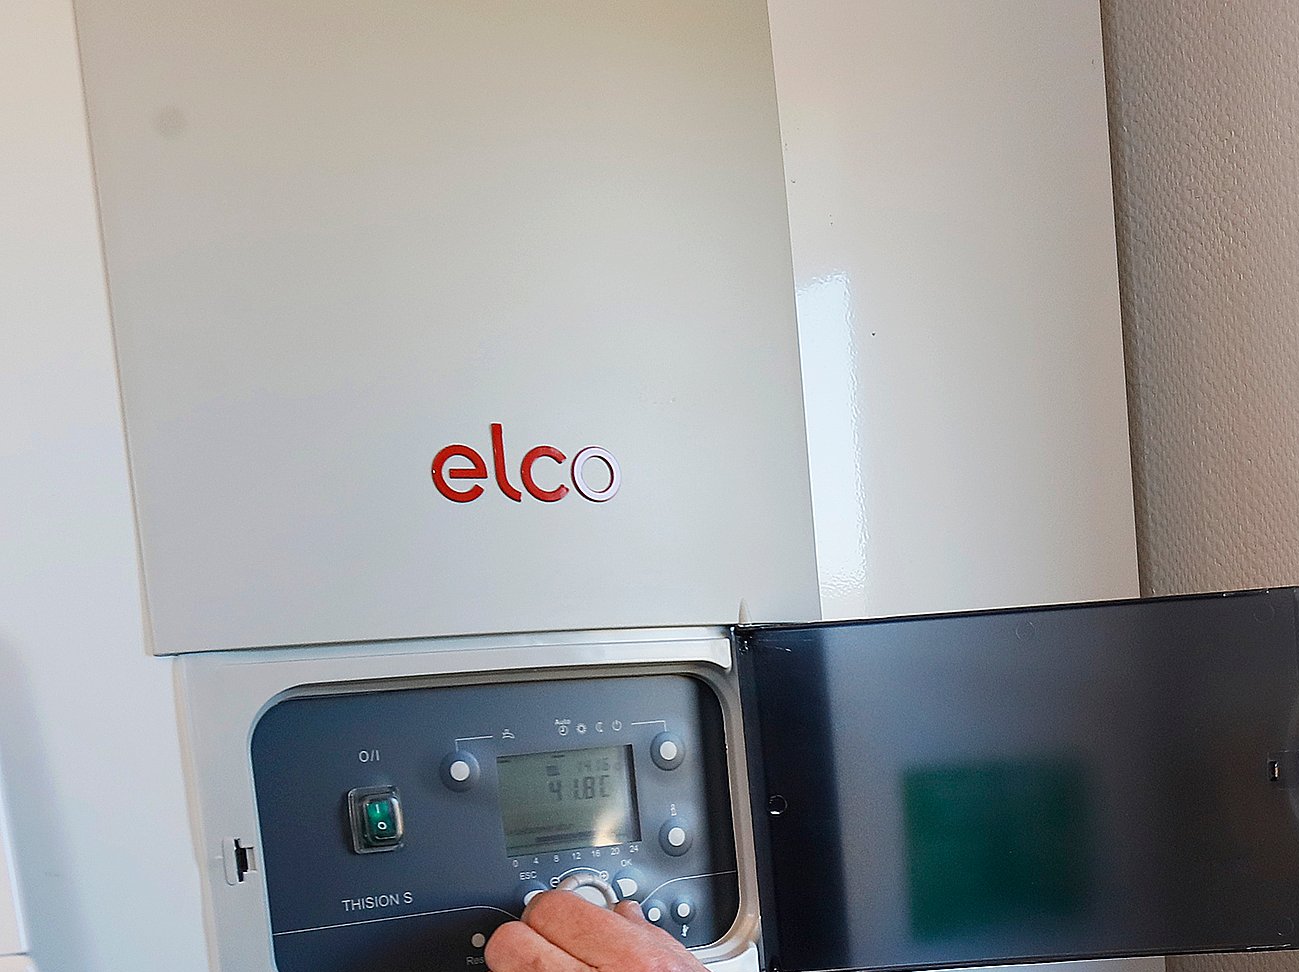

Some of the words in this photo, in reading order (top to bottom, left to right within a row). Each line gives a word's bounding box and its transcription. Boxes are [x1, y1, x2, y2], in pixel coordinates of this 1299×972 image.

[431, 422, 622, 503] elco
[554, 718, 572, 726] Auto
[553, 855, 560, 863] 8
[572, 852, 582, 860] 12
[591, 850, 601, 858] 16
[610, 847, 621, 856] 20
[629, 844, 639, 853] 24
[620, 858, 633, 867] OK
[519, 870, 538, 881] ESC
[341, 893, 400, 912] THISION
[403, 890, 414, 904] S
[466, 955, 485, 966] Res
